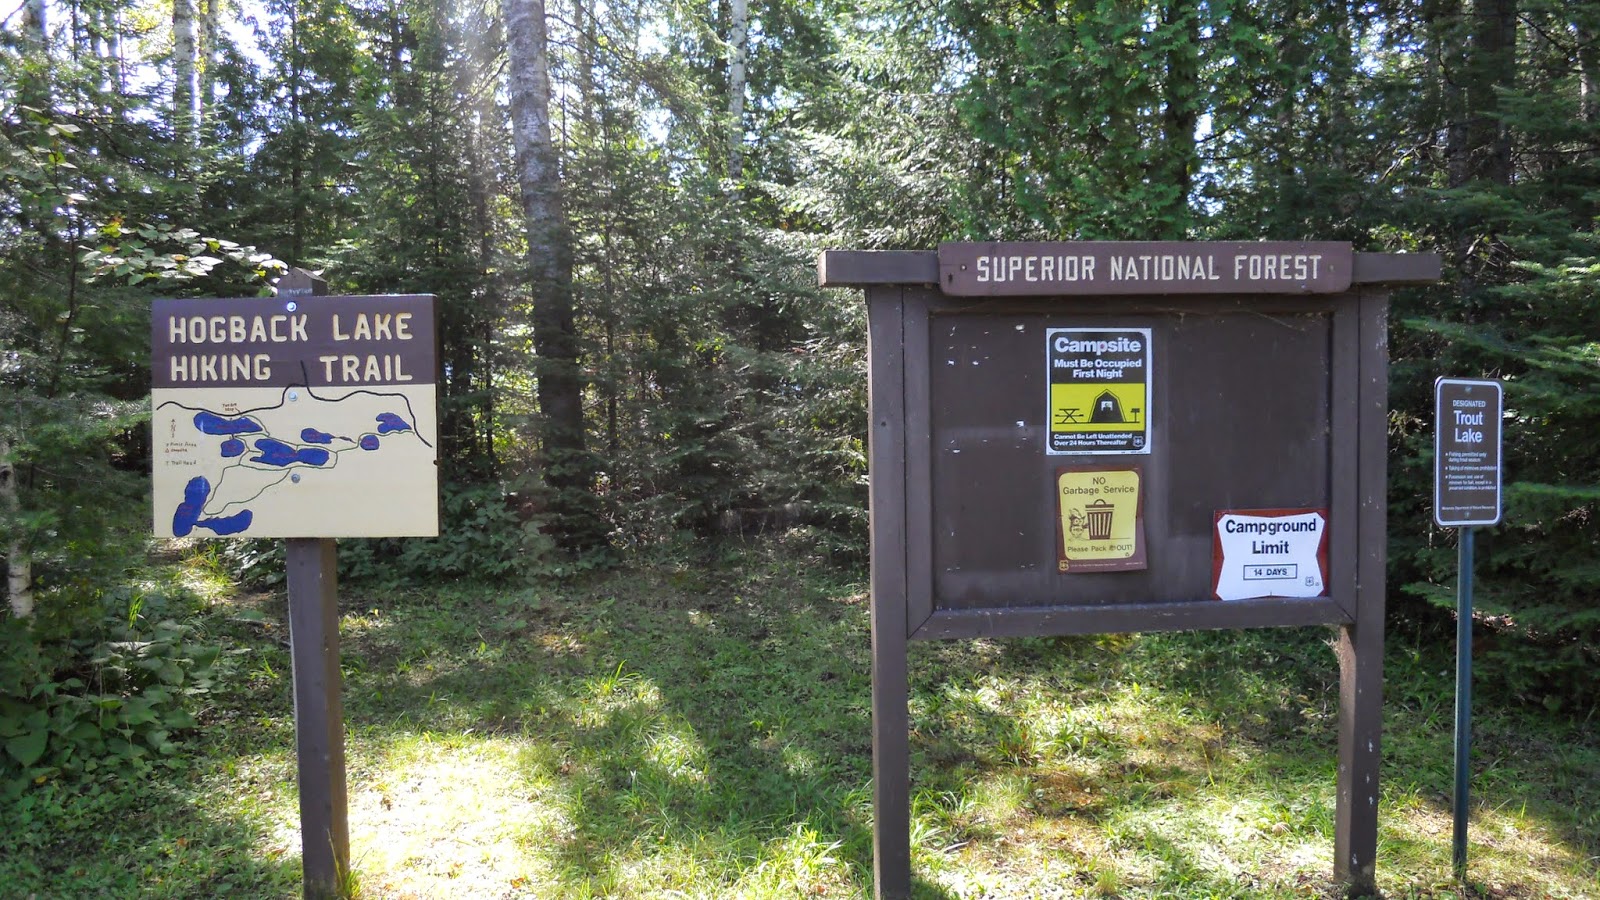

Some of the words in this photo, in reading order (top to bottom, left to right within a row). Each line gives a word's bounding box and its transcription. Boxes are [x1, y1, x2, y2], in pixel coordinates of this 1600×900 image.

[976, 256, 1096, 282] SUPERIOR
[1110, 255, 1220, 281] NATIONAL
[1233, 254, 1322, 281] FOREST
[169, 314, 308, 343] HOGBACK
[332, 313, 413, 340] LAKE
[1055, 337, 1142, 356] Campsite
[170, 354, 271, 381] HIKING
[319, 354, 413, 382] TRAIL
[1054, 359, 1079, 368] Must
[1080, 359, 1094, 368] Be
[1094, 358, 1142, 369] Occupied
[1072, 369, 1095, 378] First
[1095, 369, 1123, 380] Night
[1453, 410, 1483, 425] Trout
[1455, 428, 1483, 442] Lake
[1092, 476, 1106, 485] NO
[1062, 486, 1100, 496] Garbage
[1103, 485, 1135, 494] Service
[1225, 518, 1316, 535] Campground
[1252, 540, 1289, 554] Limit
[1253, 568, 1262, 576] 14
[1266, 568, 1288, 576] DAYS
